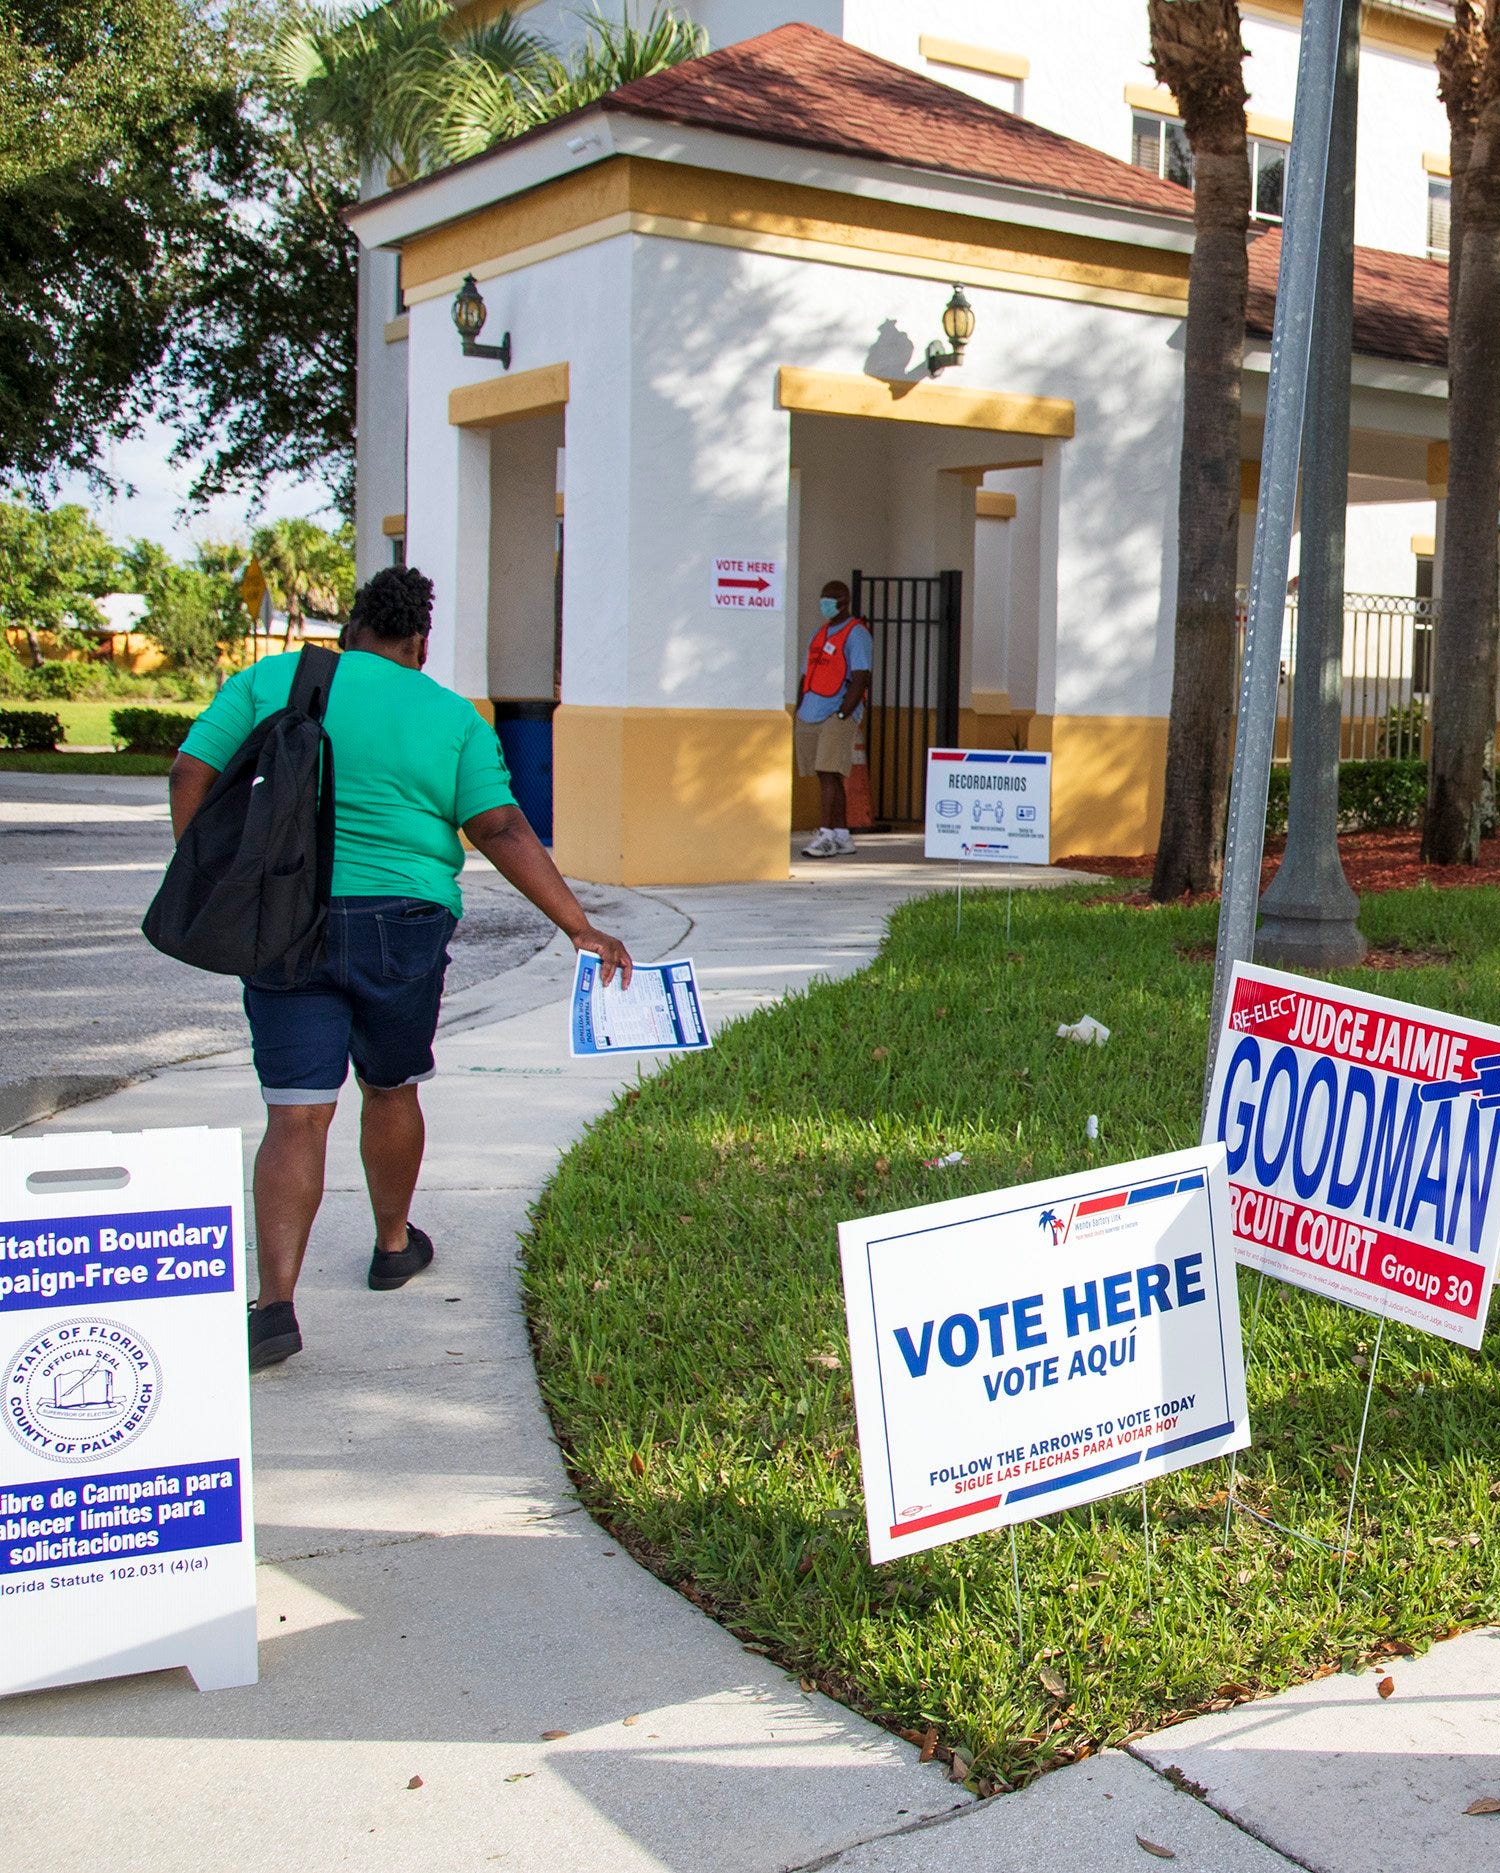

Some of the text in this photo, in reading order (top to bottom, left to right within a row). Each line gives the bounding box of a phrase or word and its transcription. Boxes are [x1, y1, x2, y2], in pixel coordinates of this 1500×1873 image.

[716, 560, 775, 574] VOTE HERE
[716, 594, 774, 608] VOTE AQUI
[948, 774, 1027, 792] RECORDATORIOS
[1232, 994, 1298, 1029] RE-ELECT
[1288, 998, 1468, 1081] JUDGE JAIMIE
[100, 1223, 228, 1252] Boundary
[157, 1257, 226, 1281] Zone
[1295, 1209, 1378, 1276] COURT
[1380, 1253, 1440, 1301] Group
[1444, 1275, 1473, 1307] 30
[893, 1252, 1206, 1379] VOTE HERE
[13, 1327, 148, 1384] STATE OF FLORIDA
[43, 1349, 120, 1377] OFFICIAL SEAL
[983, 1326, 1137, 1402] VOTE AQUÍ
[11, 1383, 153, 1454] COUNTY OF PALM BEACH
[930, 1394, 1196, 1486] FOLLOW THE ARROWS TO VOTE TODAY
[954, 1415, 1179, 1494] SIGUE LAS FLECHAS PARA VOTAR HOY
[0, 1471, 233, 1515] ibre de Campaña para
[80, 1505, 152, 1531] límites
[158, 1499, 205, 1525] para
[9, 1529, 159, 1565] solicitaciones
[50, 1572, 104, 1590] Statute
[109, 1563, 165, 1580] 102.031
[170, 1556, 209, 1574] (4)(a)
